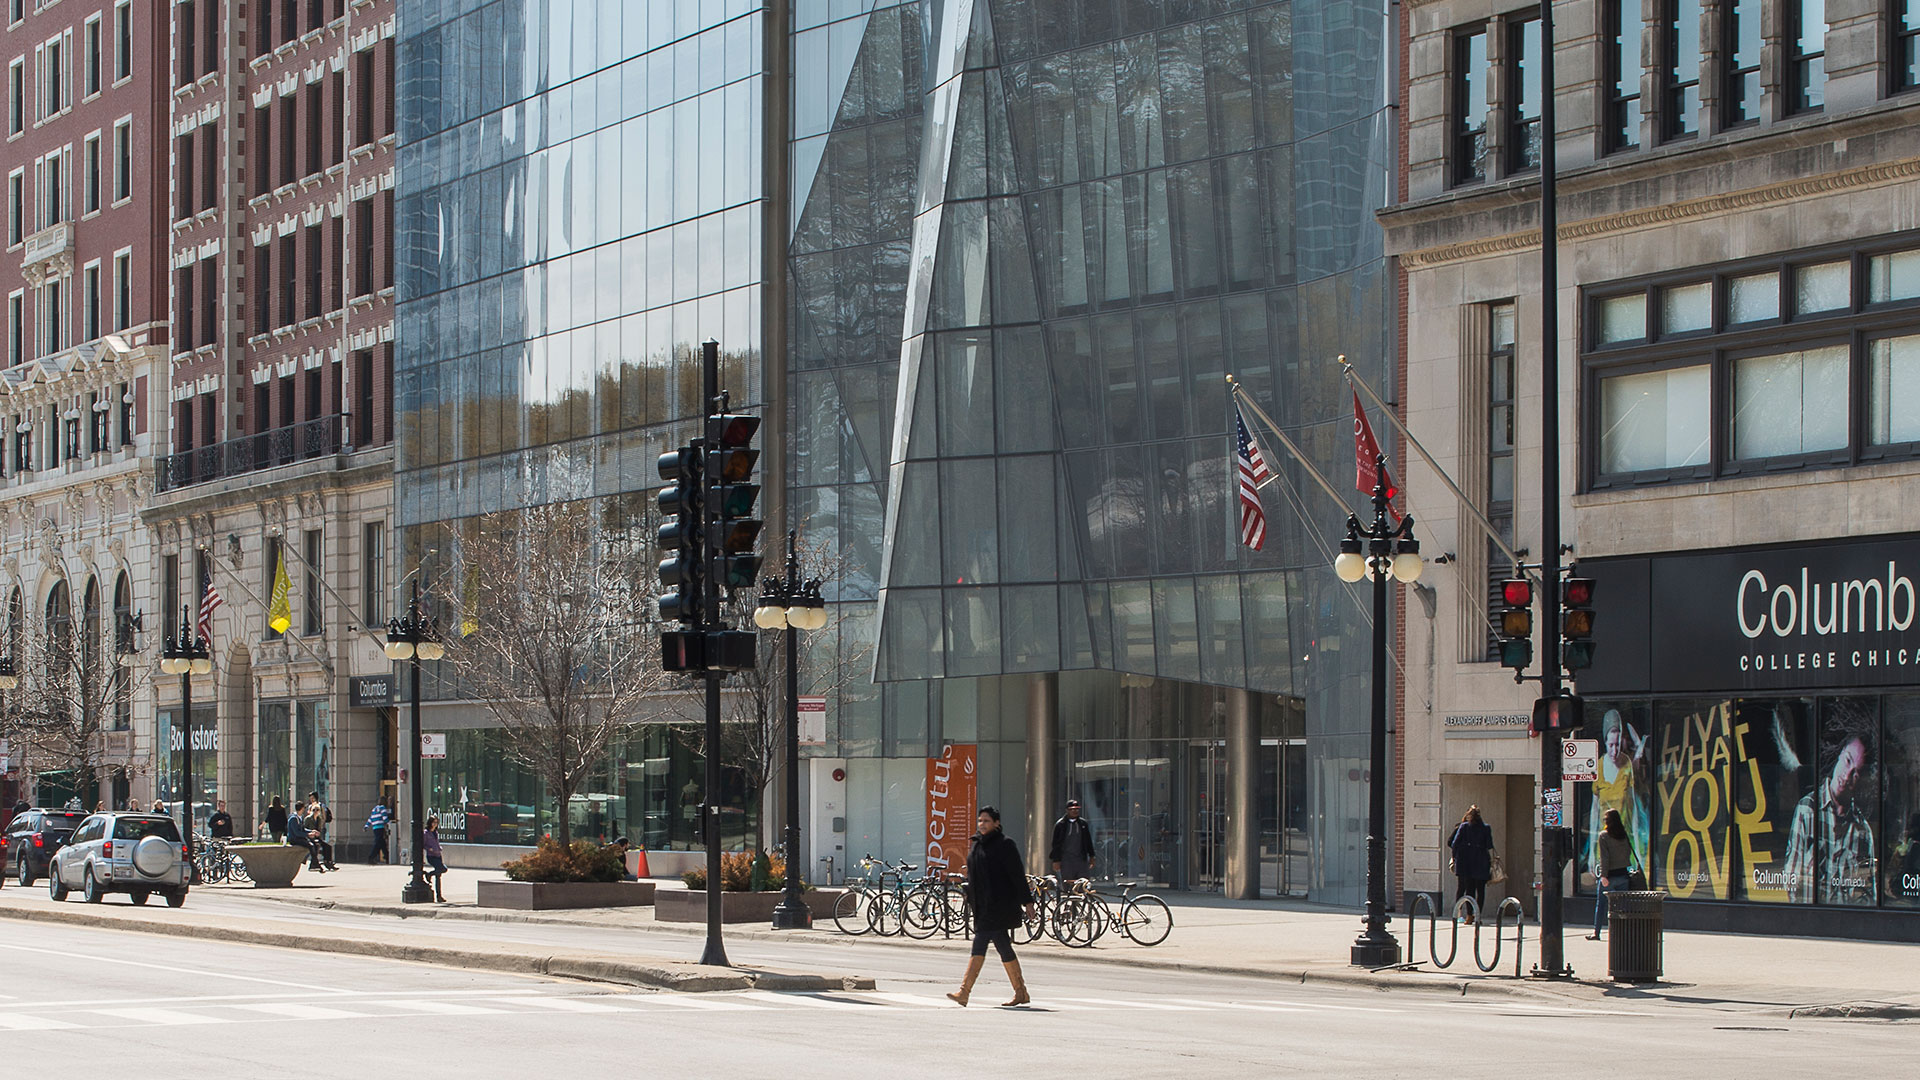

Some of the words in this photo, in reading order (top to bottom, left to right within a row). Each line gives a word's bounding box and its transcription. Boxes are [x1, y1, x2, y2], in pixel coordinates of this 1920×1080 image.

[1737, 560, 1920, 639] Columb
[1740, 652, 1836, 671] COLLEGE
[360, 679, 387, 697] Columbia
[1483, 715, 1507, 726] CAMPUS
[1507, 714, 1530, 726] CENTER
[1661, 699, 1744, 753] LIVE
[1661, 722, 1750, 782] WHAT
[1657, 757, 1767, 836] YOU
[1646, 820, 1790, 903] OVE
[1677, 871, 1709, 882] colum.edu
[1753, 868, 1797, 885] Columbia
